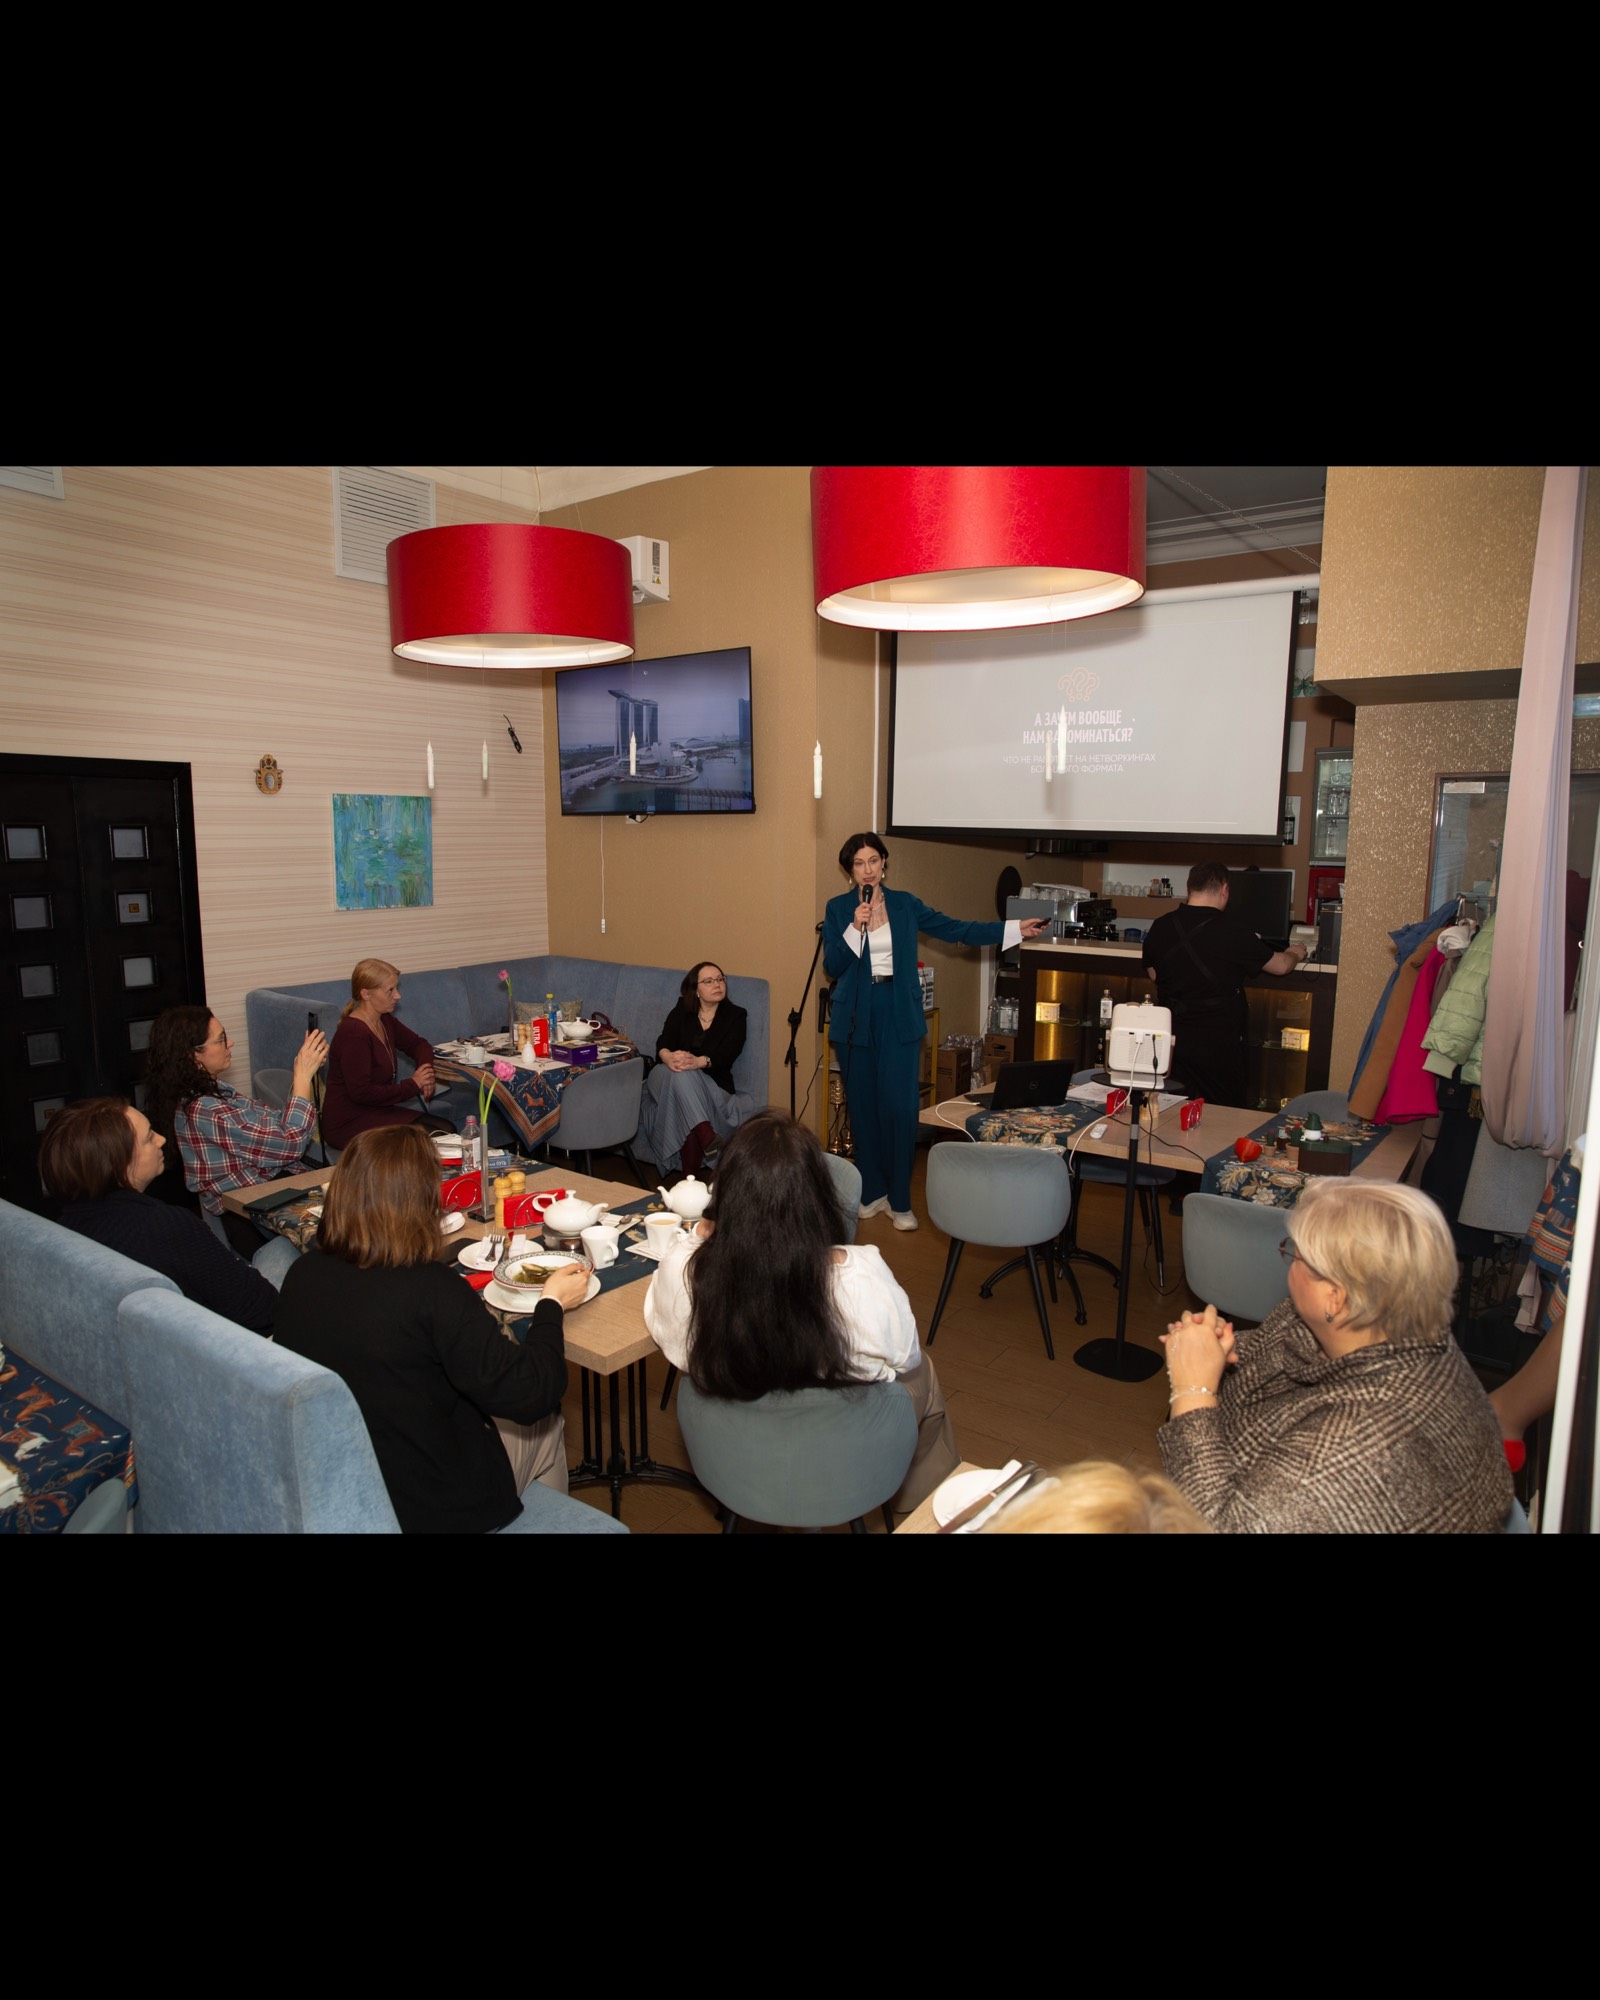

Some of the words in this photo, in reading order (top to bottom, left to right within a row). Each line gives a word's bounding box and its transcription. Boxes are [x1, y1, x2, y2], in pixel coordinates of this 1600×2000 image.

[1034, 713, 1042, 726] А
[1044, 711, 1076, 726] ЗАМ
[1078, 709, 1122, 725] ВООБЩЕ
[1023, 730, 1044, 745] НАМ
[1046, 727, 1134, 744] ЗАОМИНАТЬСЯ?
[1003, 756, 1019, 764] ЧТО
[1021, 755, 1032, 764] НЕ
[1076, 754, 1087, 763] НА
[1089, 753, 1156, 763] НЕТВОРКИНГАХ
[1081, 764, 1123, 773] ФОРМАТА
[533, 1026, 541, 1045] ULTRA
